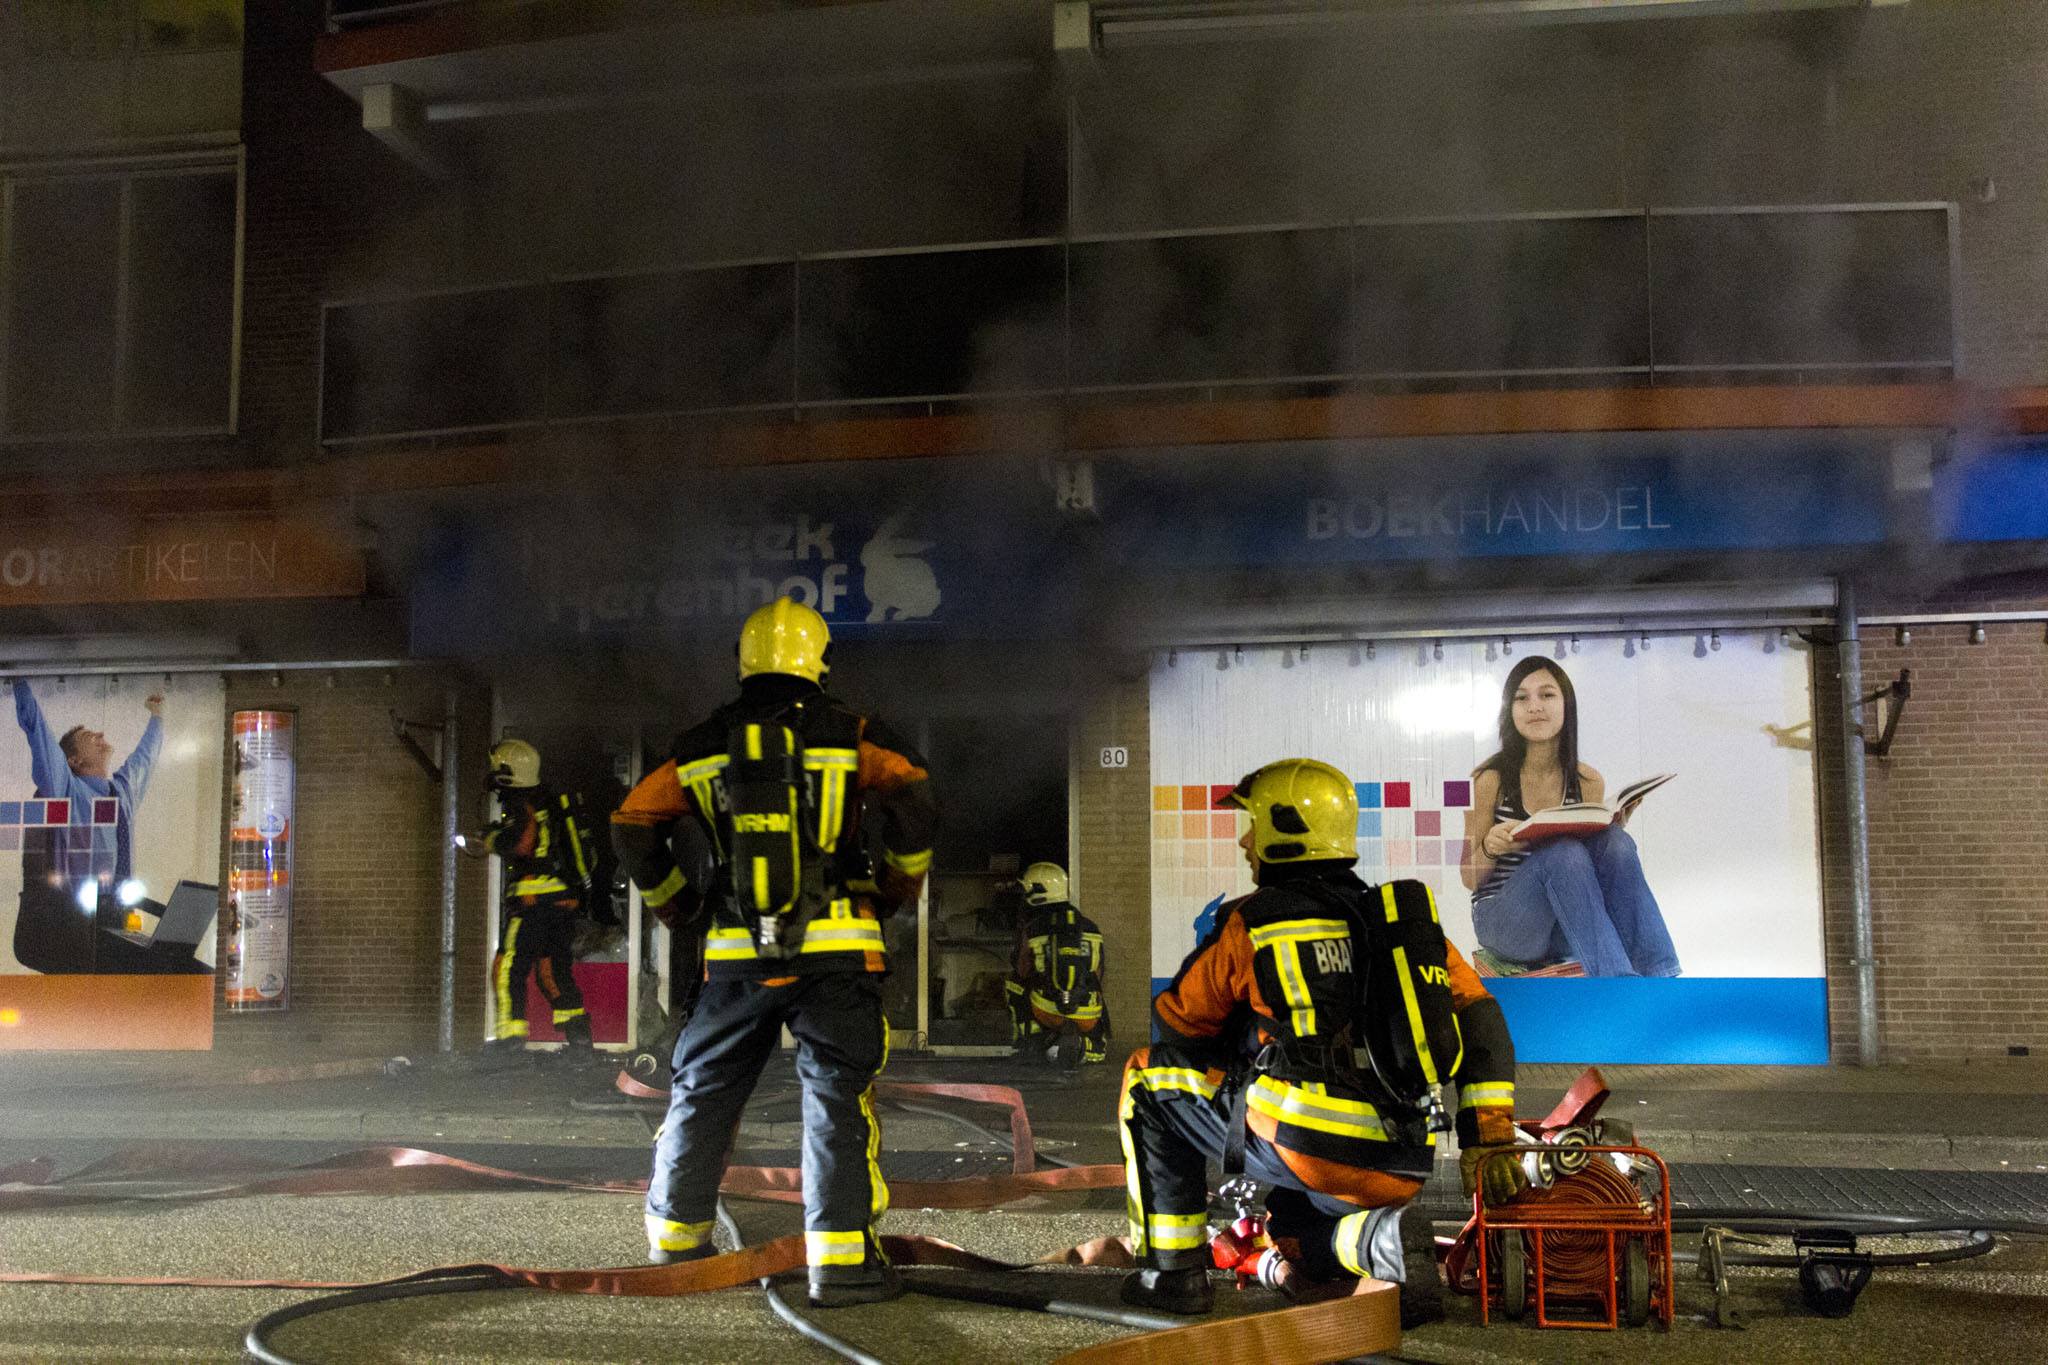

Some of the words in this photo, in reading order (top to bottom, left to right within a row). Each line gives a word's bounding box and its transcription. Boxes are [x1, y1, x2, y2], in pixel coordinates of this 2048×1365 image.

[1306, 486, 1671, 540] BOEKHANDEL
[1102, 749, 1125, 765] 80
[1312, 938, 1353, 974] BRA
[1418, 965, 1452, 988] VR
